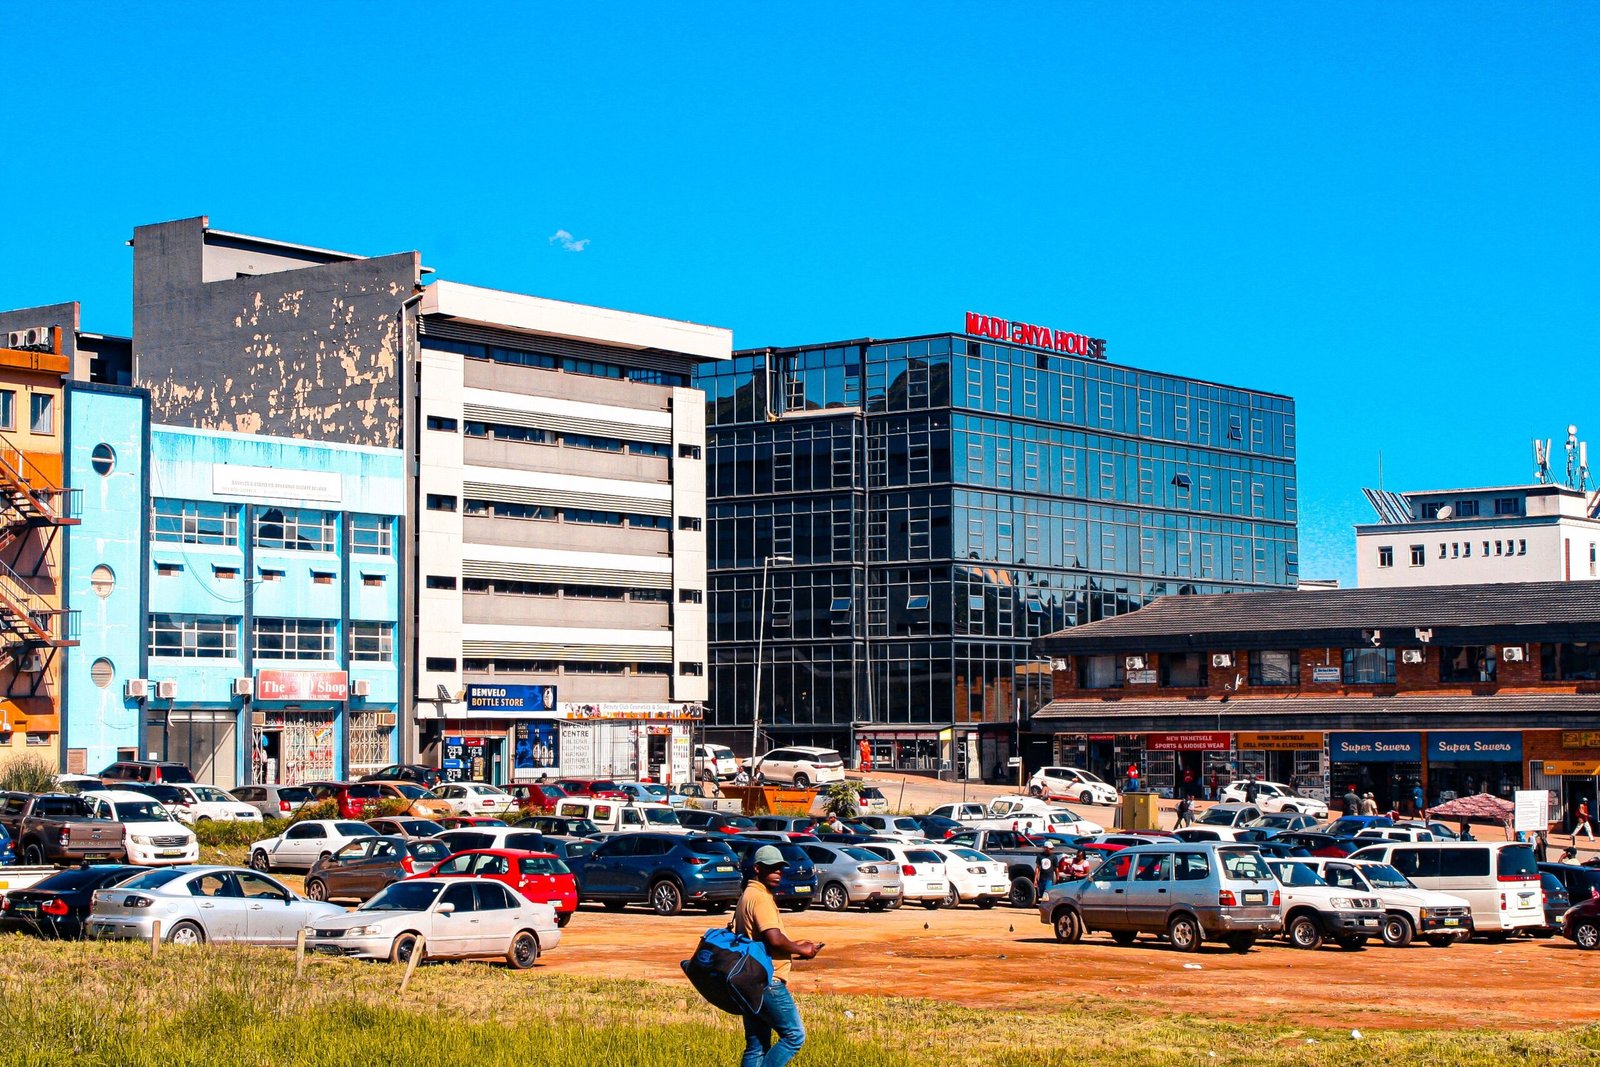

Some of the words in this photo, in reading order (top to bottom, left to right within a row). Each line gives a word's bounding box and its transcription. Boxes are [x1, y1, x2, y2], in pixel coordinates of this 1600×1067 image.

[1055, 329, 1108, 360] HOUSE
[262, 681, 286, 693] The
[318, 680, 346, 696] Shop
[471, 688, 507, 697] BEMVELO
[471, 698, 499, 706] BOTTLE
[501, 698, 524, 707] STORE
[1341, 742, 1372, 753] Super
[1375, 741, 1411, 751] Savers
[1438, 742, 1471, 753] Super
[1474, 741, 1511, 751] Savers
